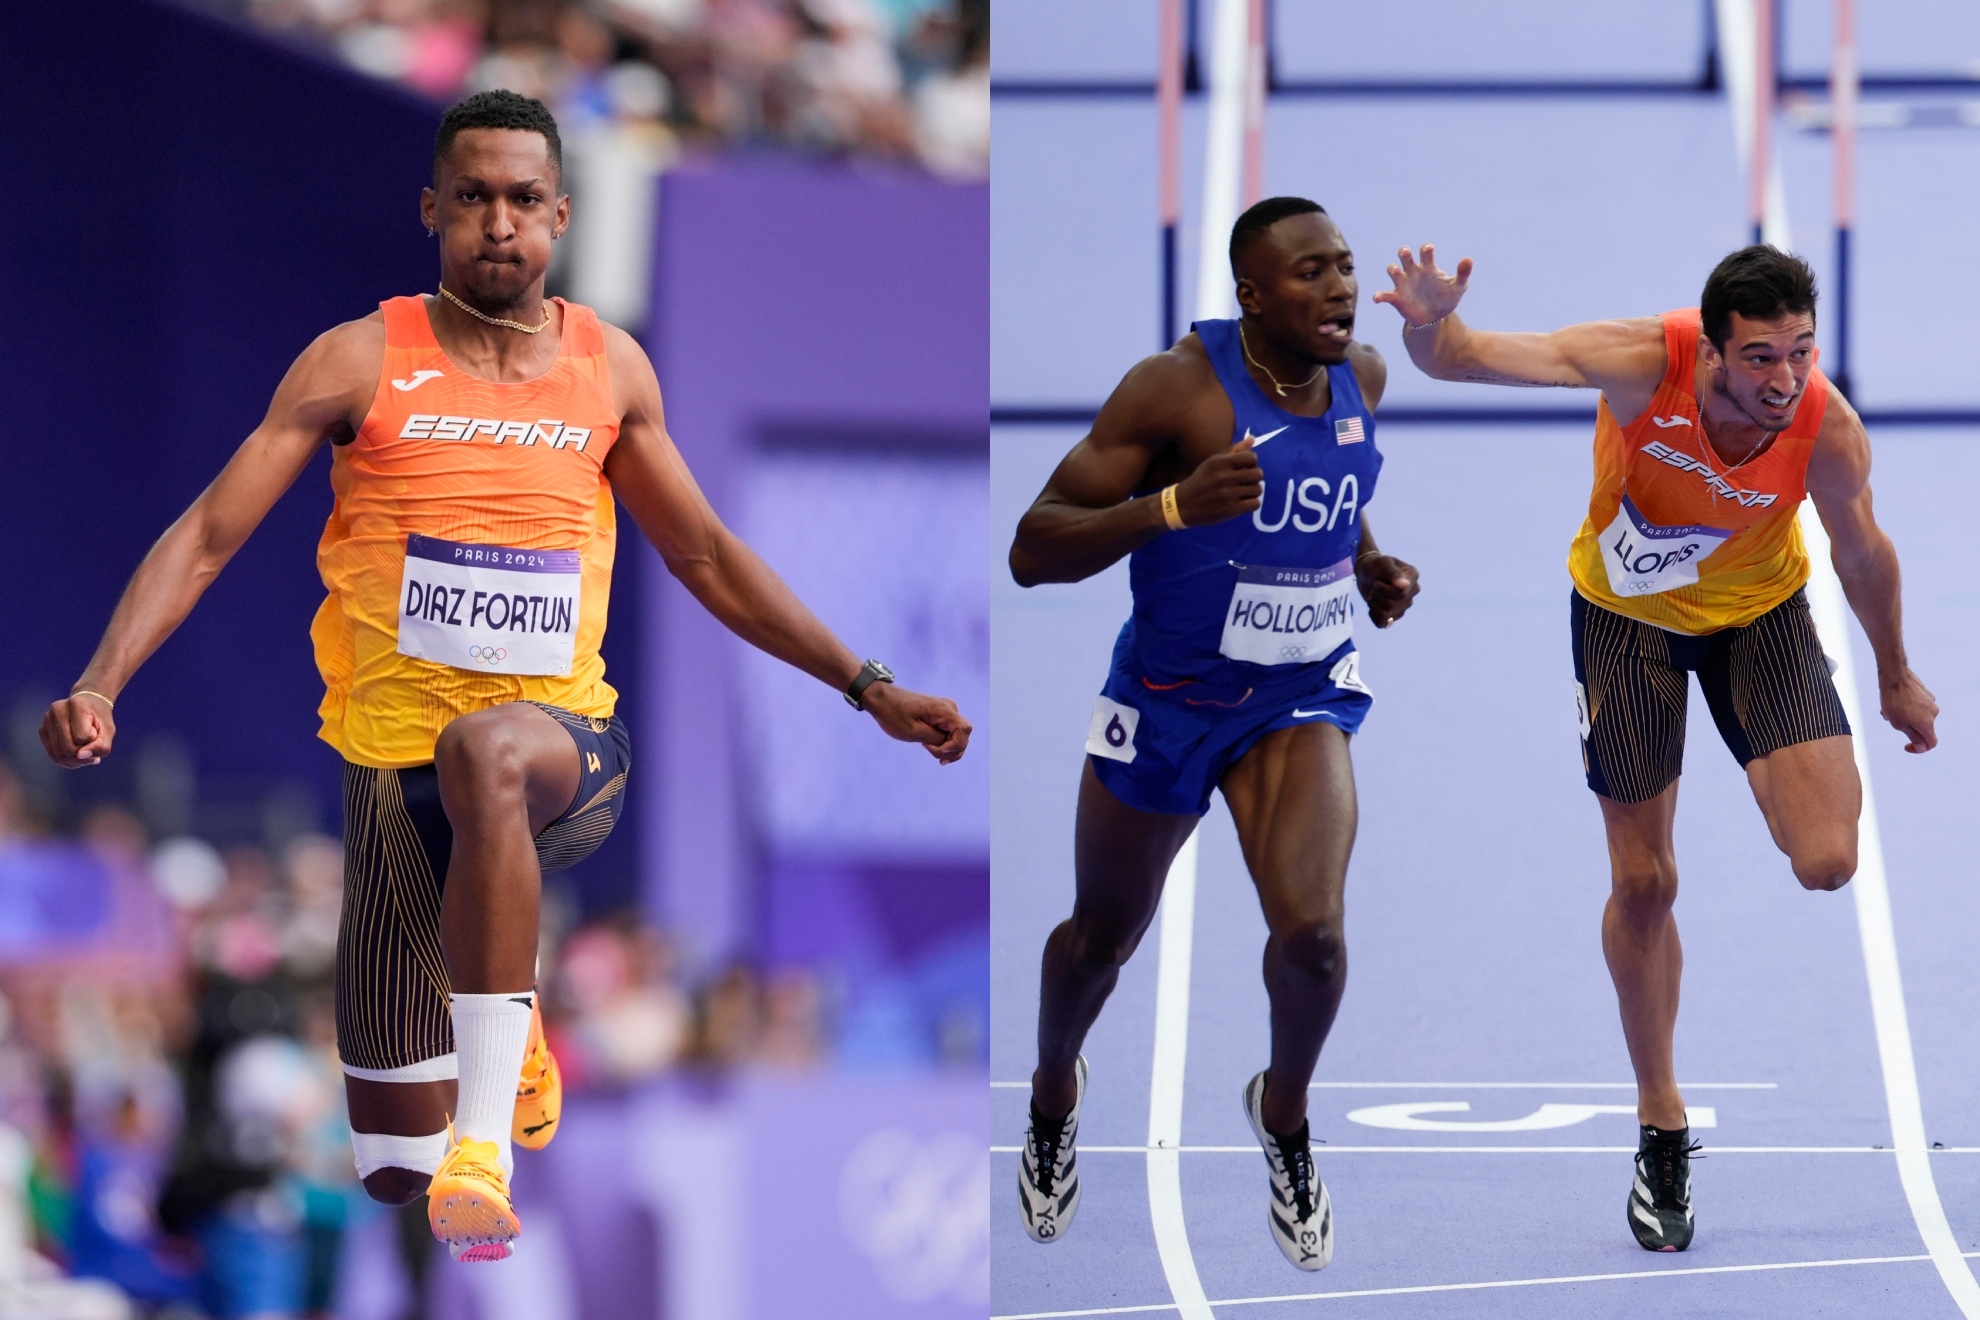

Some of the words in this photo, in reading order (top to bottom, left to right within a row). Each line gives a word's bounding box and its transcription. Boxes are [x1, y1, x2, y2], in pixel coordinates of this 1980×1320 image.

[399, 413, 593, 453] ESPAÑA
[1640, 440, 1779, 508] ESPAÑA
[1252, 473, 1359, 533] USA
[1640, 522, 1672, 536] PARIS
[454, 547, 499, 564] PARIS
[505, 552, 545, 568] 2024
[1613, 529, 1700, 574] LLOPIS
[1276, 572, 1310, 583] PARIS
[405, 579, 467, 626] DIAZ
[469, 590, 573, 634] FORTUN
[1231, 593, 1349, 634] HOLLOWAY
[1105, 712, 1127, 748] 6
[1346, 1101, 1718, 1132] 5
